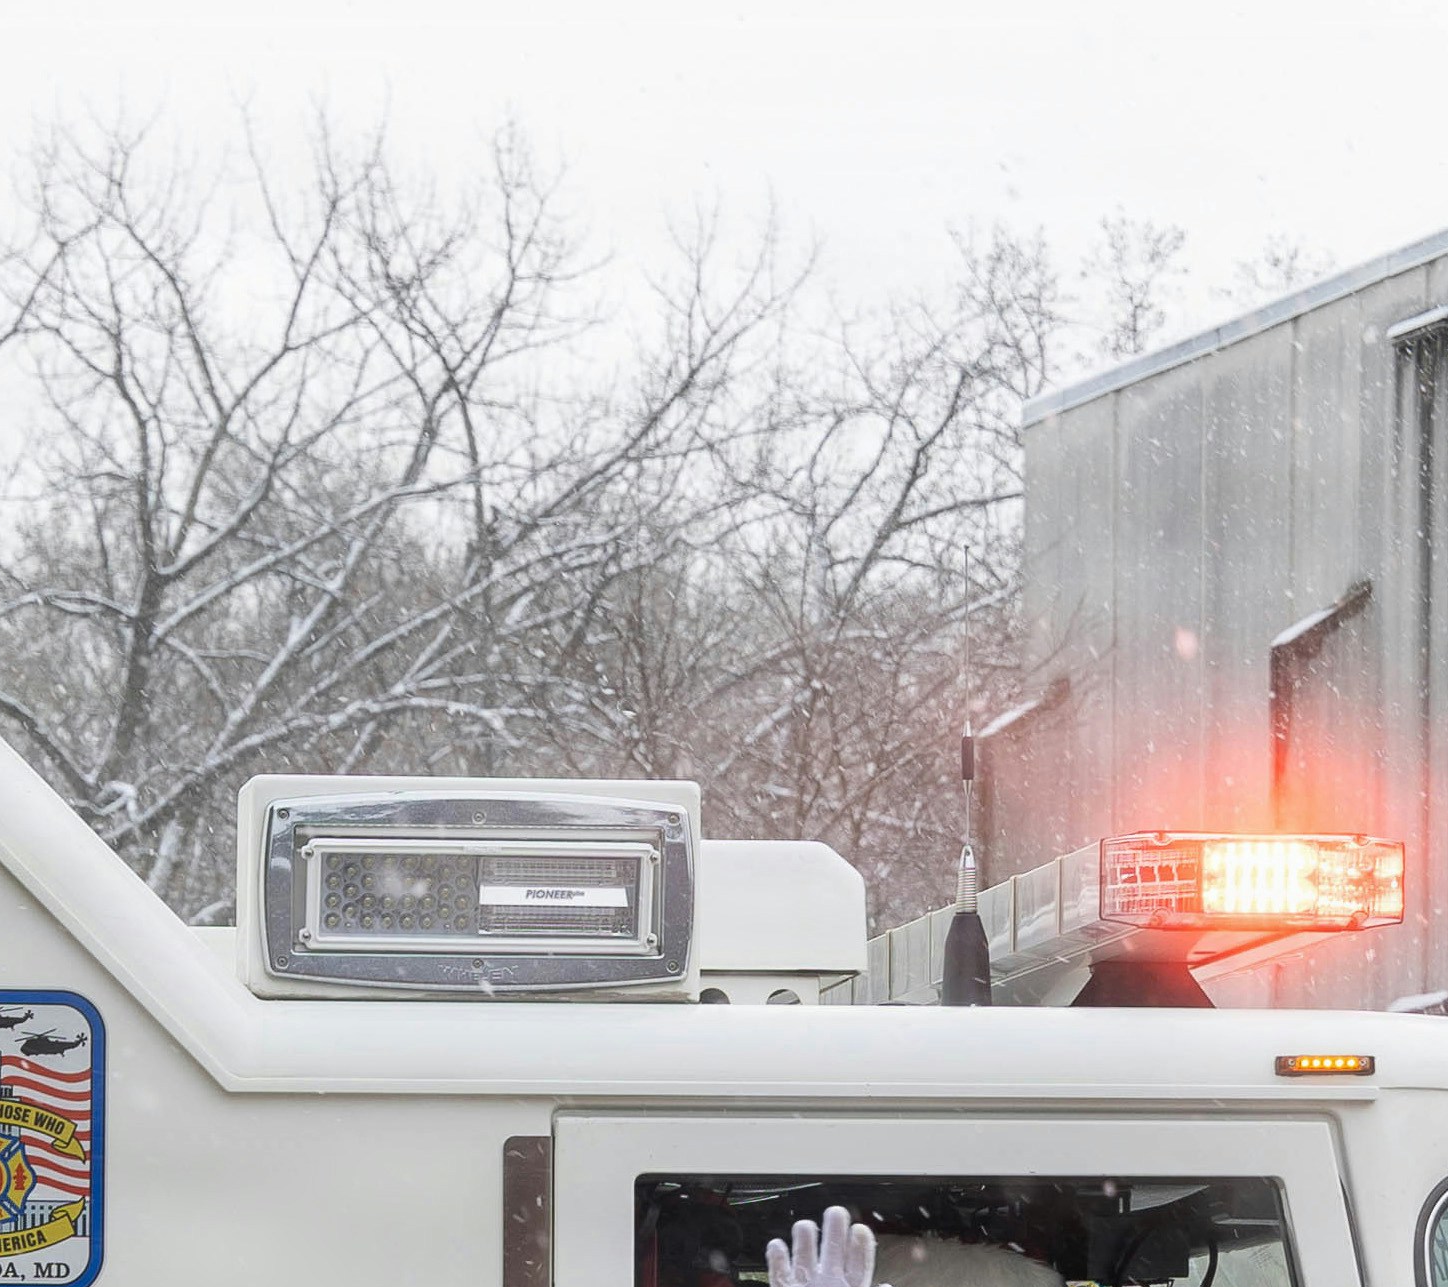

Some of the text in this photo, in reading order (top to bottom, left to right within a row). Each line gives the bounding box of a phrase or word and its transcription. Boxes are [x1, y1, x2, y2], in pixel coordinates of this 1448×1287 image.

[526, 889, 573, 899] PIONEER
[33, 1113, 66, 1135] WHO
[33, 1262, 70, 1278] MD
